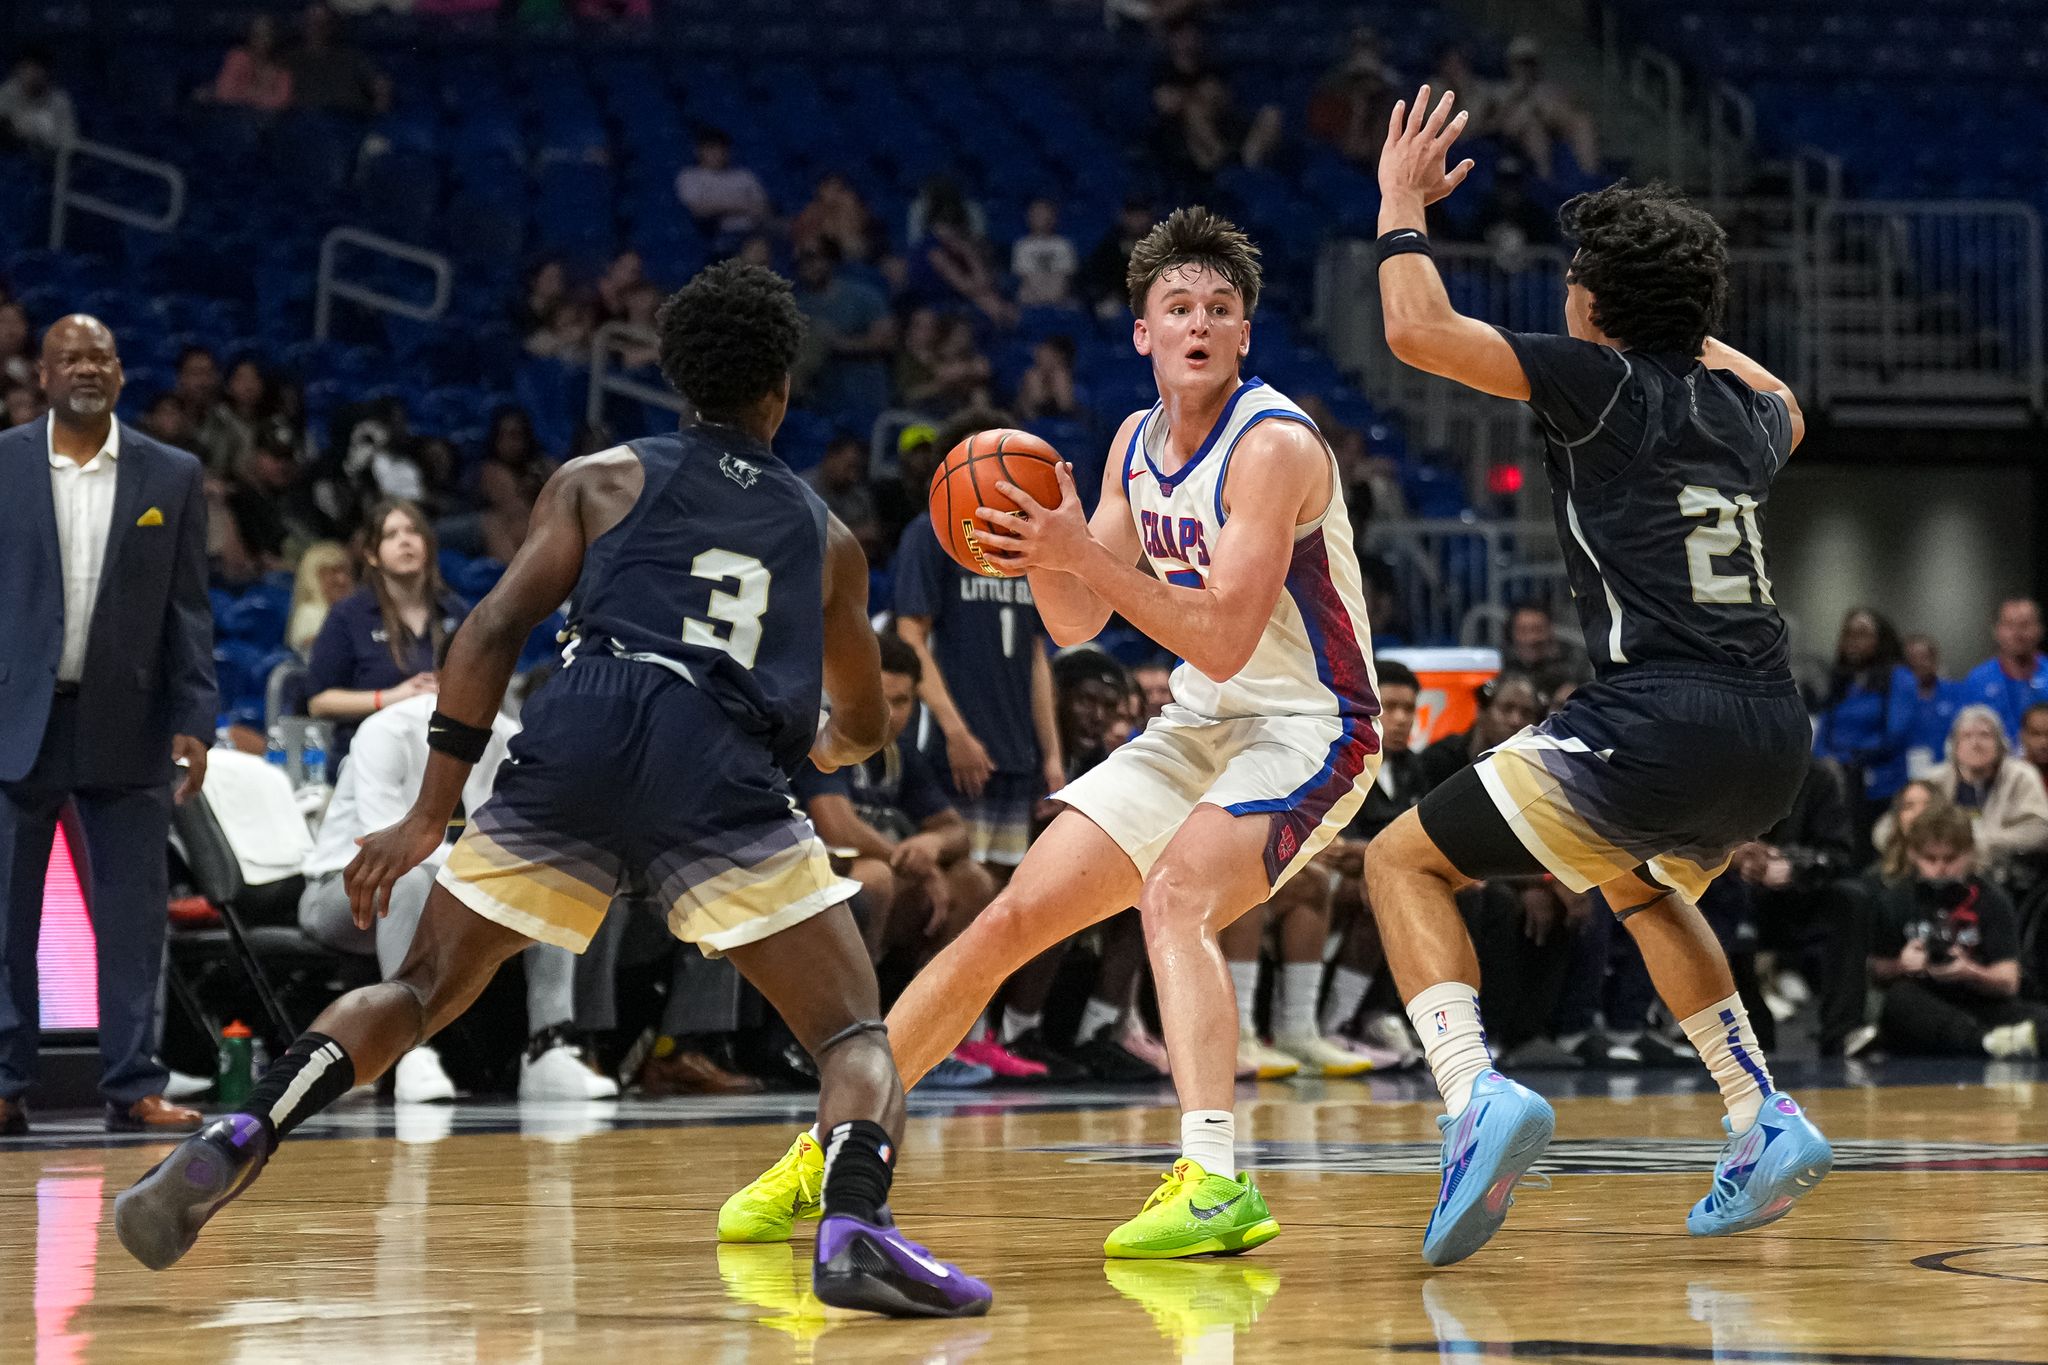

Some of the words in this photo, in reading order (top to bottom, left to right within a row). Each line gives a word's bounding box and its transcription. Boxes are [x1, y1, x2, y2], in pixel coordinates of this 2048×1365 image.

[1141, 509, 1211, 567] CHAPS
[1677, 484, 1776, 606] 21
[681, 547, 772, 671] 3
[960, 577, 1013, 604] LITTLE
[1000, 606, 1015, 659] 1
